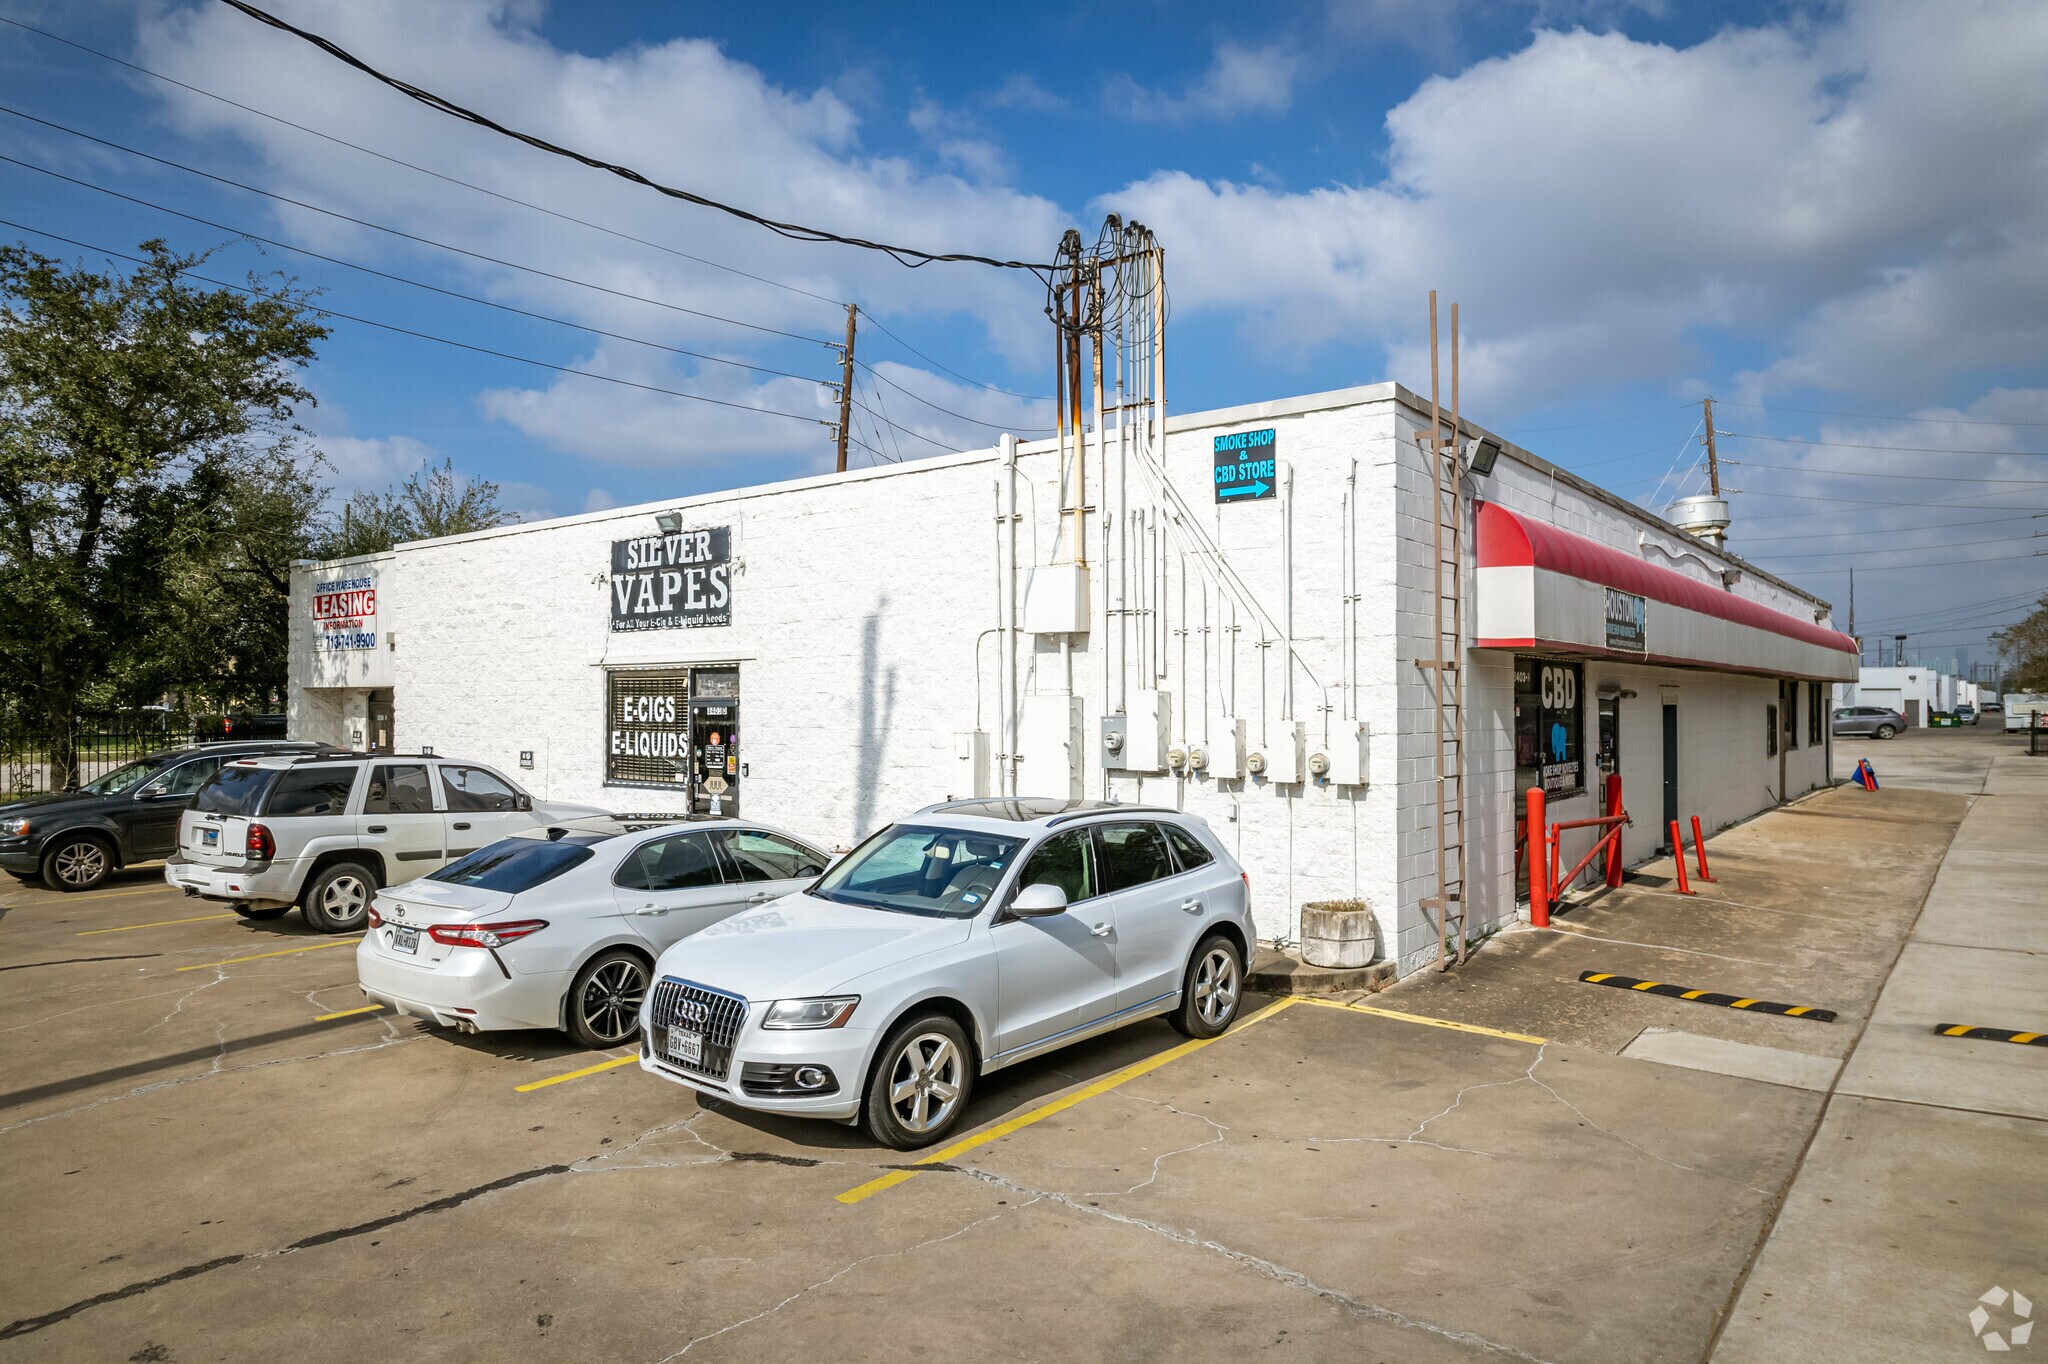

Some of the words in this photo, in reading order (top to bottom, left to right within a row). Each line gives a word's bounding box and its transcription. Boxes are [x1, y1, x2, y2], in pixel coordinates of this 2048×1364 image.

[1214, 434, 1247, 452] SMOKE
[1248, 429, 1275, 447] SHOP
[1239, 450, 1248, 460] &
[1215, 464, 1236, 483] CBD
[1238, 459, 1274, 480] STORE
[627, 531, 712, 569] SILVER
[316, 581, 335, 593] OFFICE
[336, 577, 371, 589] WAREHOUSE
[612, 563, 728, 614] VAPES
[313, 591, 374, 619] LEASING
[1605, 589, 1634, 624] HOUSTON
[323, 619, 363, 631] INFORMATION
[635, 618, 649, 628] Your
[651, 616, 666, 628] E-Cig
[668, 616, 673, 626] &
[675, 614, 703, 628] E-Liquid
[325, 632, 375, 649] 713-741-9900
[1541, 666, 1576, 709] CBD
[624, 696, 675, 722] E-CIGS
[611, 731, 688, 758] E-LIQUIDS
[679, 1030, 691, 1039] TEXAS
